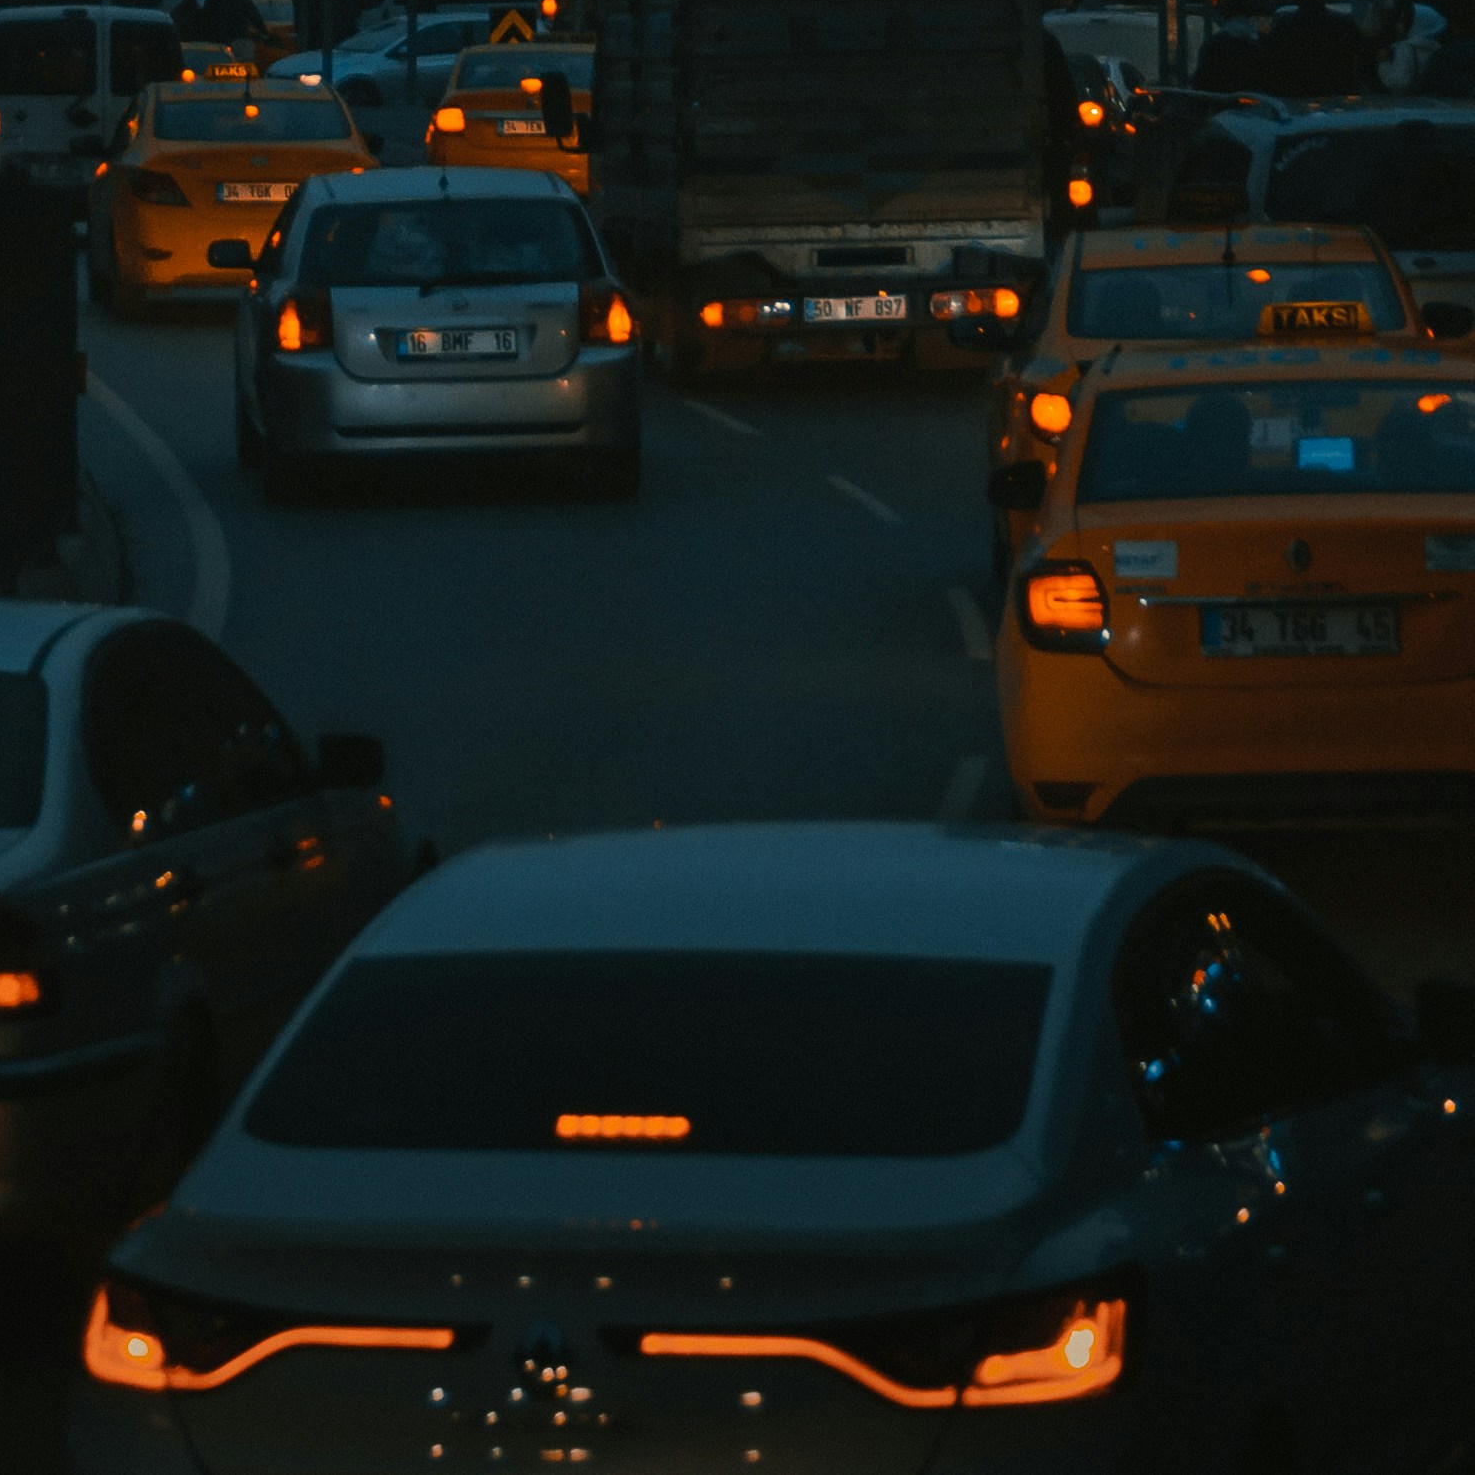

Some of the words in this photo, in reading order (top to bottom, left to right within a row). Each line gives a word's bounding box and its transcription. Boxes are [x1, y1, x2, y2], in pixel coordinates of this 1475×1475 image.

[411, 333, 427, 352] 16
[494, 331, 512, 350] 16
[1221, 612, 1254, 641] 34
